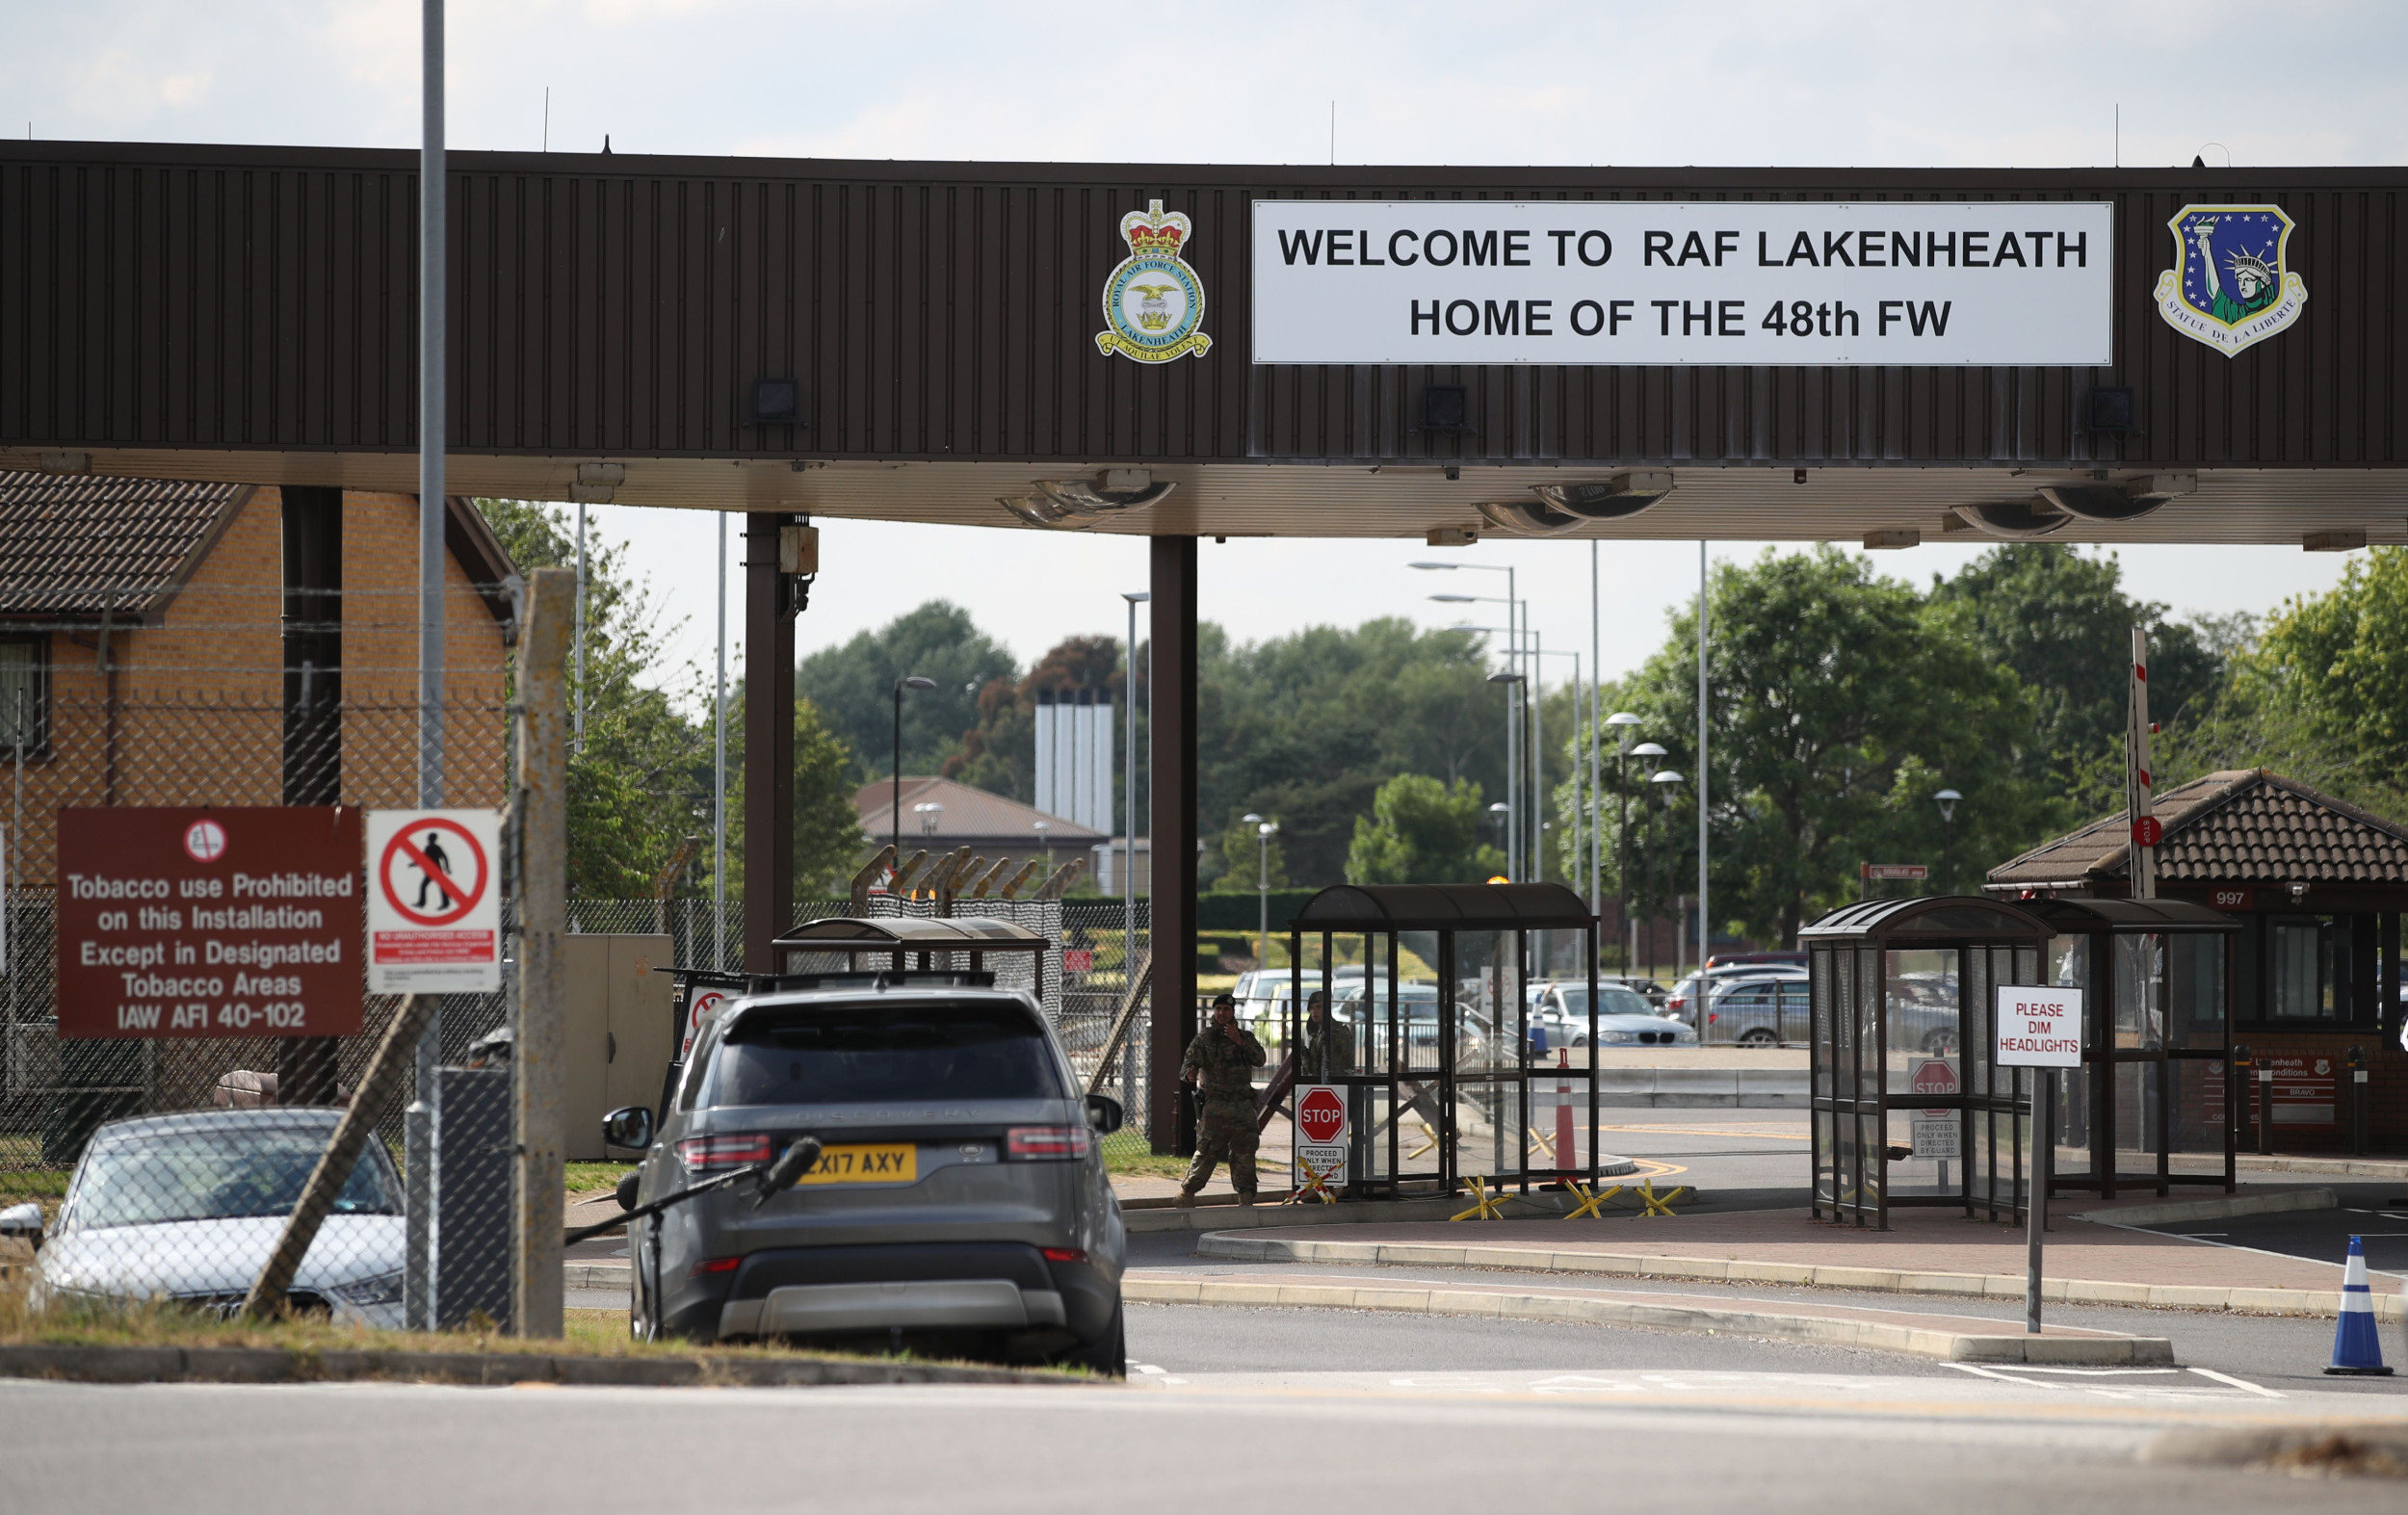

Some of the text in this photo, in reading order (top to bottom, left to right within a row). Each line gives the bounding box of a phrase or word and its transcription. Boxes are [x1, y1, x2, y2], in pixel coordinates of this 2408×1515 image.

[1278, 229, 2087, 268] WELCOME TO RAF LAKENHEATH
[1112, 262, 1195, 309] ROYAL AIR FORCE STATION
[1410, 299, 1952, 337] HOME OF THE 48th FW
[2166, 299, 2296, 344] STATUE DE LA LIBERTE
[1121, 325, 1187, 346] LAKENHEATH
[1123, 345, 1162, 360] AQUILAE
[1165, 338, 1199, 357] VOLENT
[2142, 820, 2151, 844] STOP
[67, 872, 353, 899] Tobacco use Prohibited
[2216, 892, 2244, 904] 997
[98, 903, 323, 931] on this Installation
[81, 938, 341, 970] Except in Designated
[121, 972, 301, 998] Tobacco Areas
[118, 1002, 305, 1030] IAW AFI 40-102
[2016, 1003, 2064, 1017] PLEASE
[2028, 1021, 2052, 1034] DIM
[2000, 1038, 2079, 1054] HEADLIGHTS
[2255, 1058, 2303, 1067] Lenheath
[2269, 1067, 2308, 1077] onditions
[1916, 1083, 1955, 1095] STOP
[797, 1109, 981, 1121] DISCOVERY
[1303, 1109, 1341, 1123] STOP
[807, 1152, 906, 1175] X17 AXY
